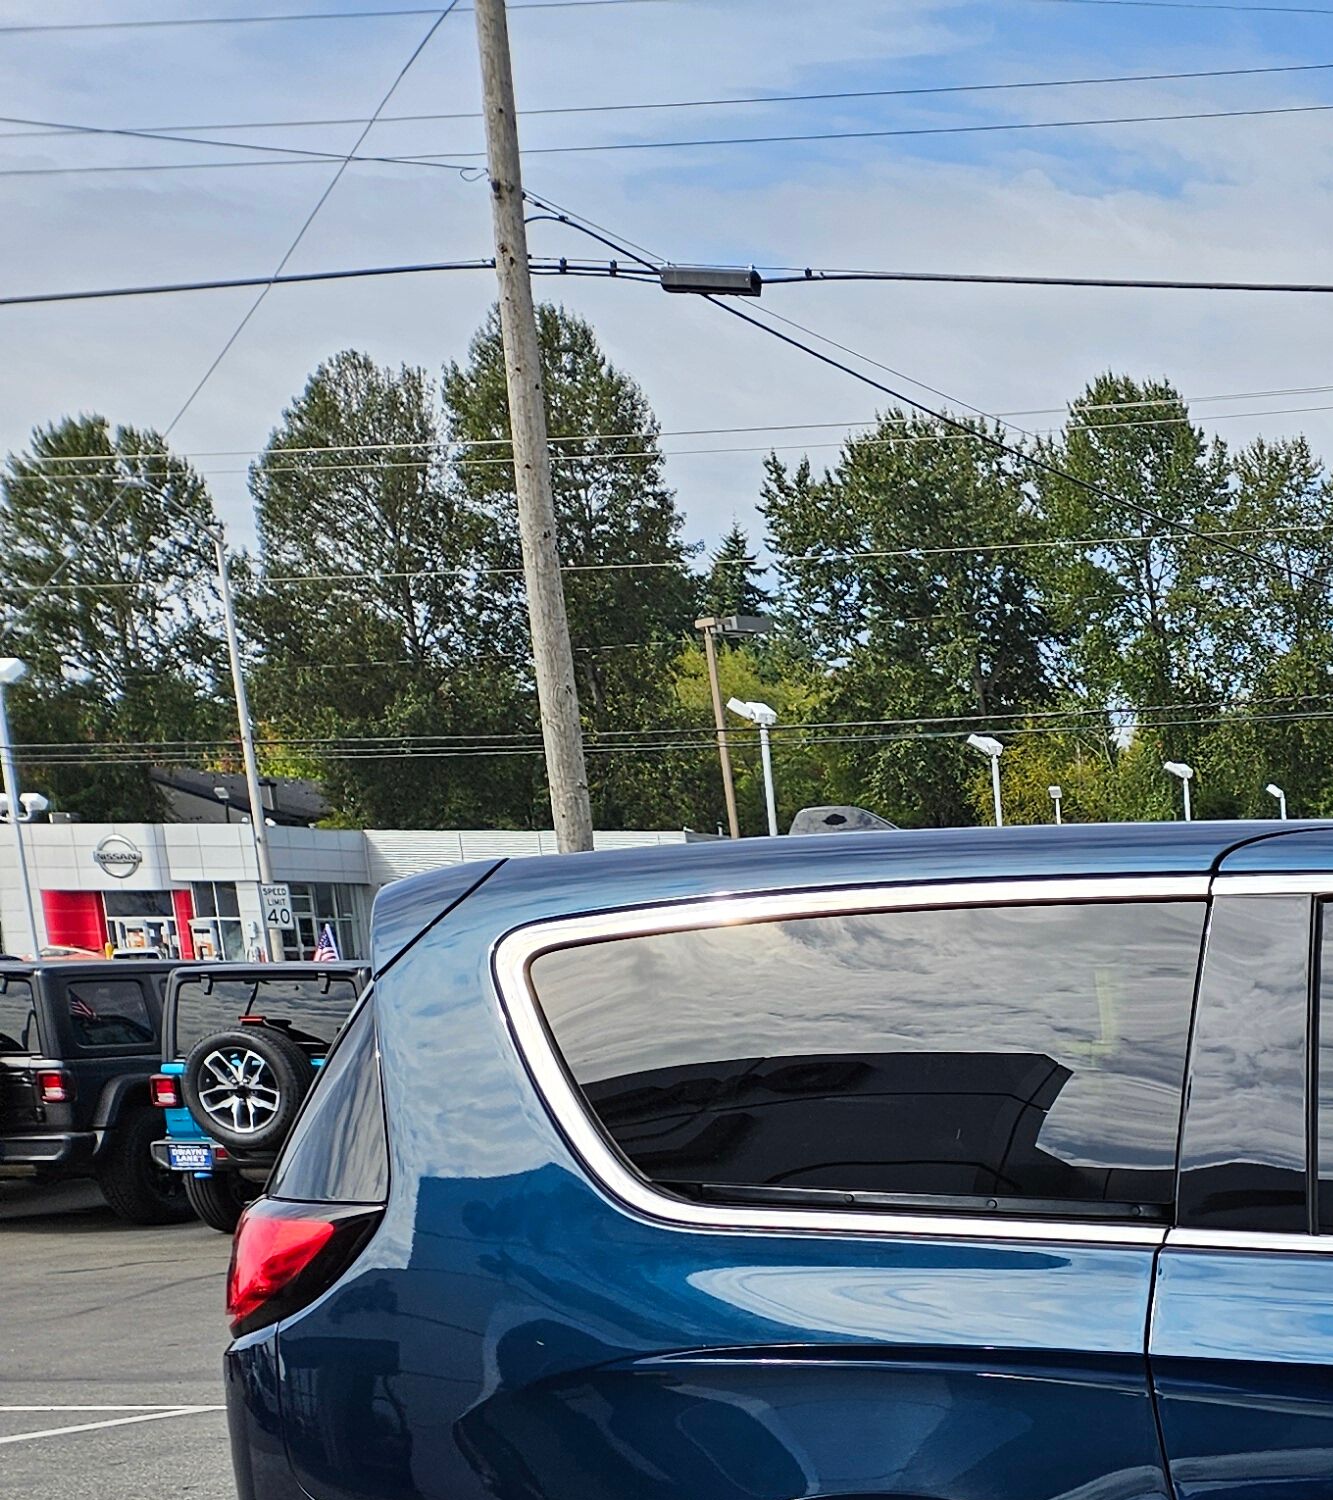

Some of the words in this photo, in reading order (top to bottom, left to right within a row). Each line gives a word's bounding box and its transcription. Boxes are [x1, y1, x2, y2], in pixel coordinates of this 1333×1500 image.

[262, 887, 287, 896] SPEED
[267, 898, 286, 906] LIMIT
[267, 908, 290, 924] 40
